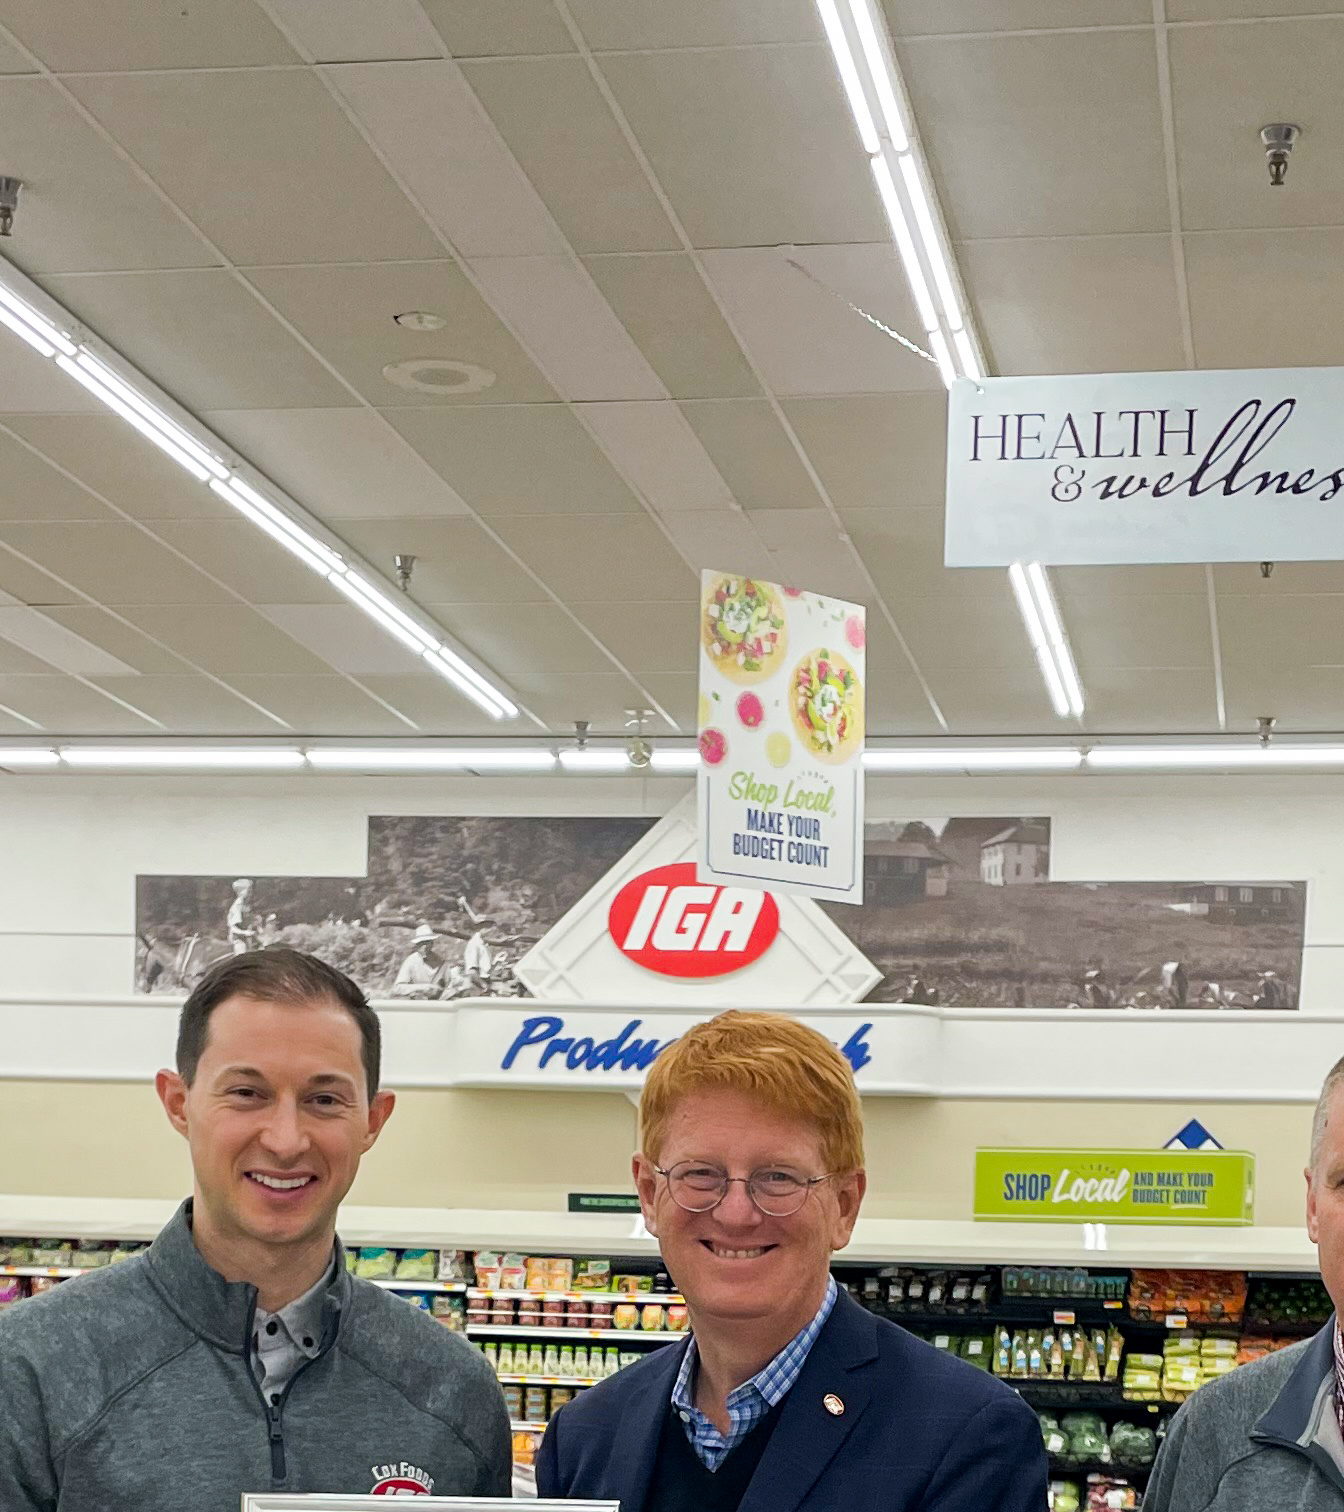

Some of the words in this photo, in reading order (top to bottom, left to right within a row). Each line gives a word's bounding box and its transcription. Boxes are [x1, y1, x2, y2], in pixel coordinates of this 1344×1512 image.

[969, 408, 1199, 461] HEALTH
[1051, 464, 1087, 502] &
[728, 771, 778, 812] Shop
[746, 808, 784, 835] MAKE
[787, 814, 820, 841] YOUR
[733, 832, 784, 861] BUDGET
[787, 841, 829, 868] COUNT
[623, 885, 766, 952] IGA
[501, 1016, 676, 1072] Produ
[1003, 1173, 1051, 1201] SHOP
[1051, 1168, 1130, 1203] Local
[1133, 1172, 1154, 1187] AND
[1157, 1172, 1184, 1187] MAKE
[1187, 1172, 1214, 1187] YOUR
[1132, 1189, 1171, 1204] BUDGET
[1173, 1189, 1208, 1204] COUNT
